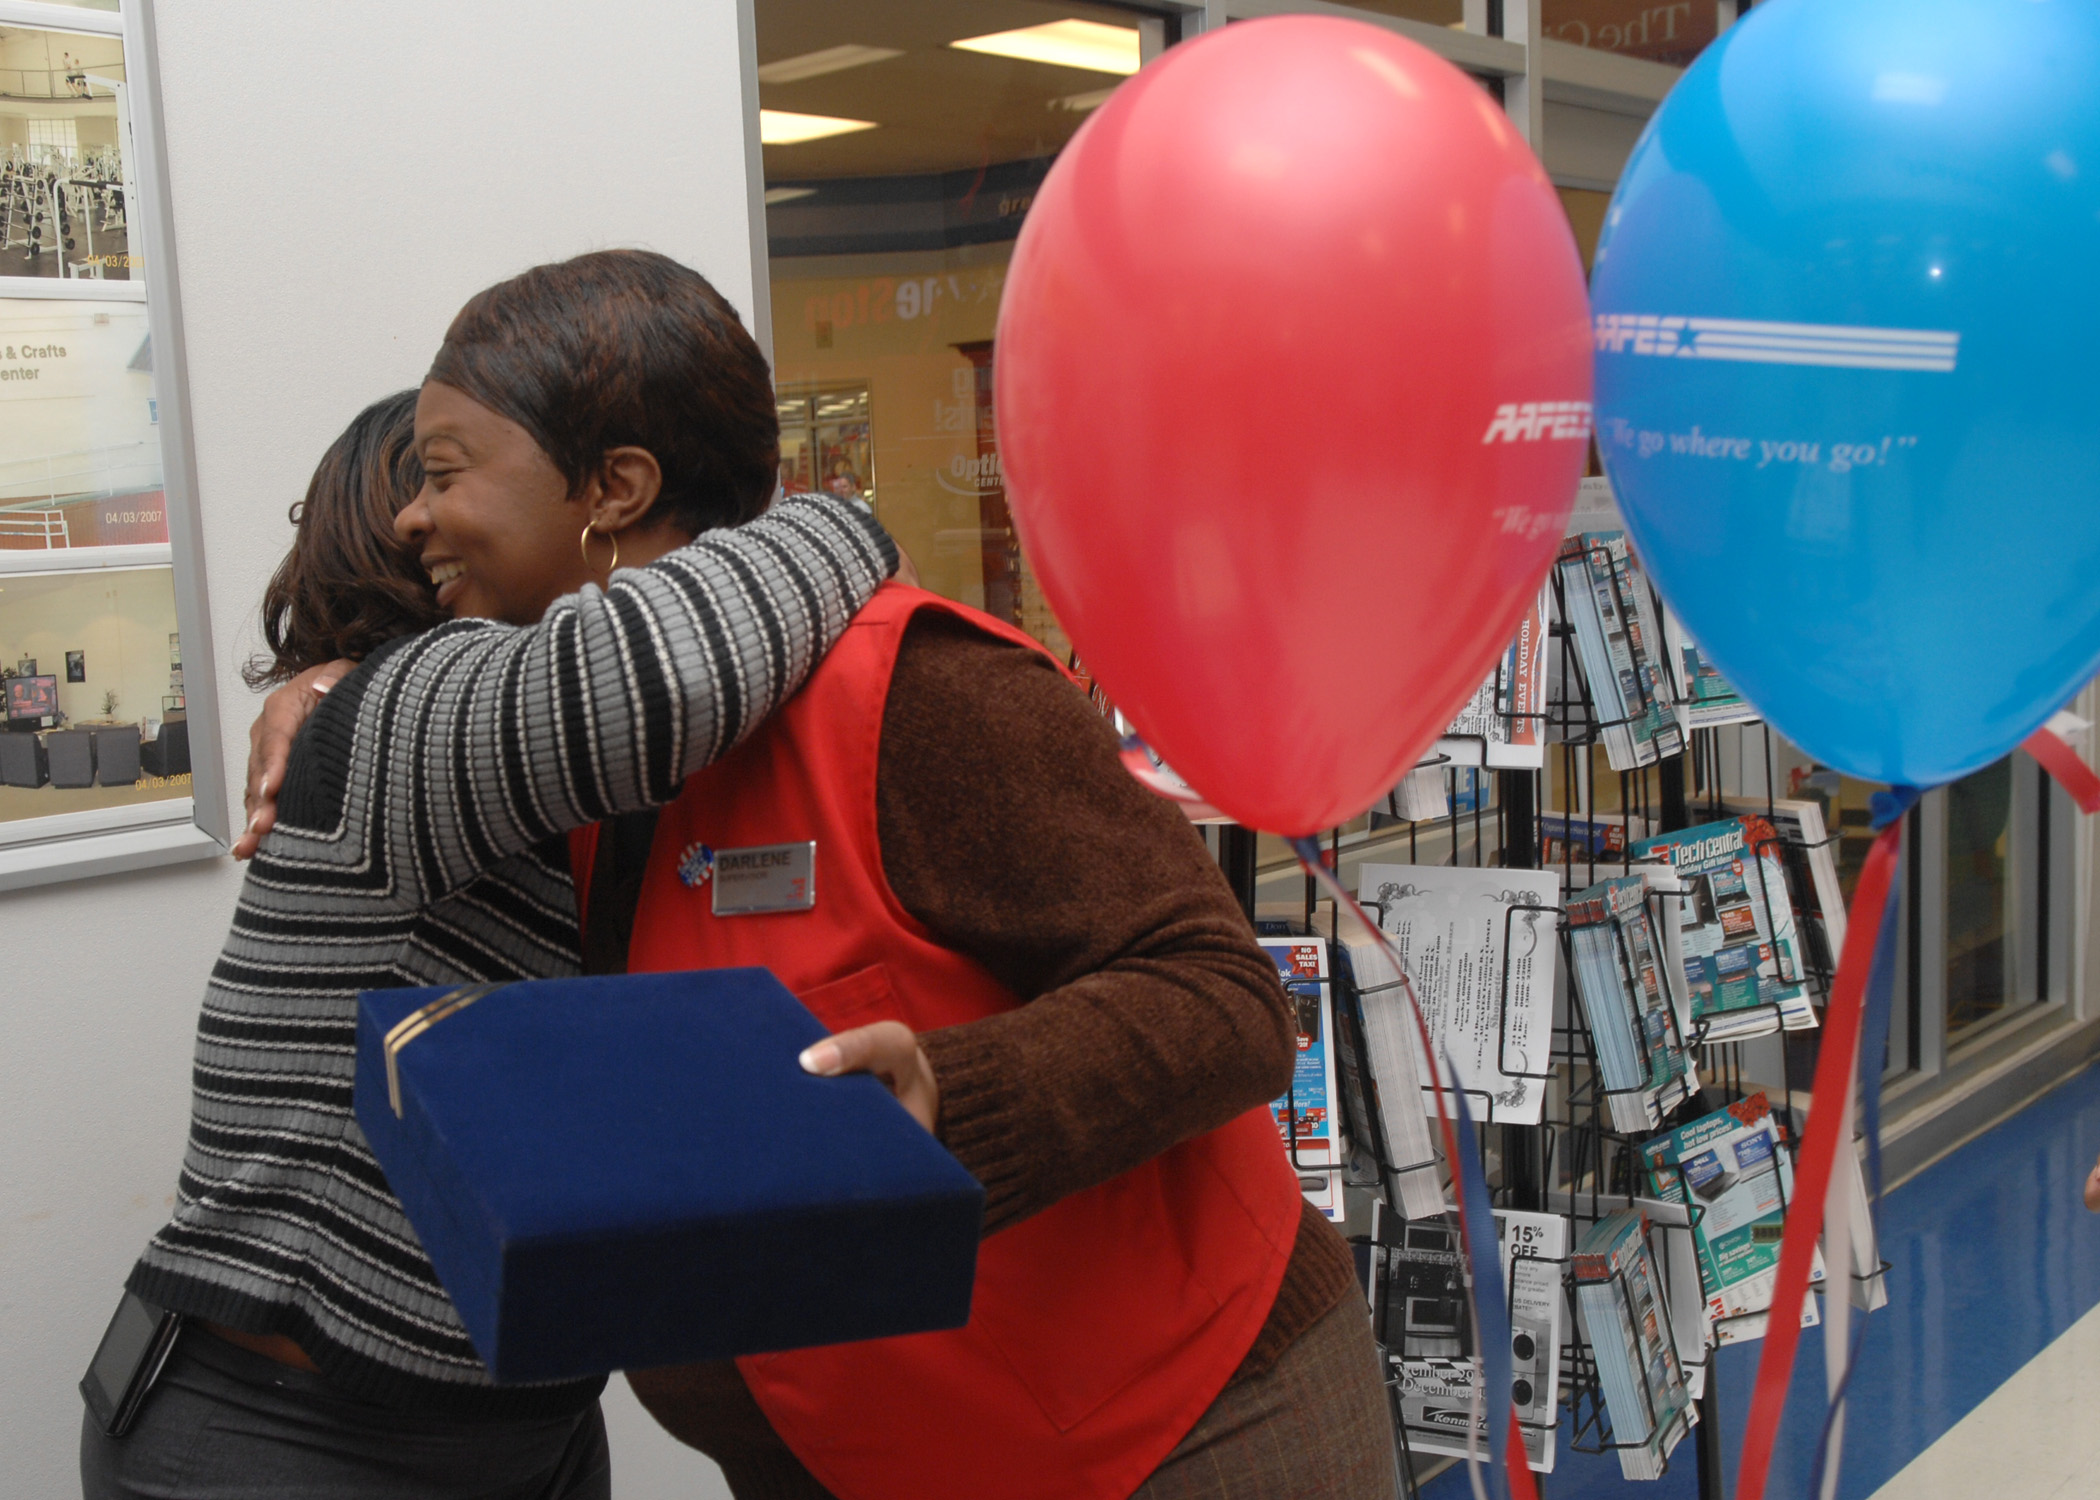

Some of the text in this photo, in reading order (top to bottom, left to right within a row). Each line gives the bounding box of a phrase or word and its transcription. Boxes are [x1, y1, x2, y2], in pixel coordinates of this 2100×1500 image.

[6, 344, 67, 359] & Crafts
[0, 366, 40, 380] enter
[1638, 430, 1664, 459] go
[1669, 425, 1752, 460] where
[1755, 437, 1820, 470] you
[105, 511, 162, 524] 04/03/2007
[1519, 619, 1530, 677] HOLIDAY
[135, 772, 192, 791] 04/03/2007
[1671, 828, 1744, 867] Tech Central
[719, 851, 792, 871] DARLENE
[1681, 1126, 1696, 1140] Cool
[1741, 1134, 1763, 1149] SONY
[1512, 1224, 1544, 1244] 15%
[1511, 1243, 1539, 1257] OFF
[1523, 1298, 1550, 1308] DELIVERY
[1402, 1377, 1471, 1399] December
[1433, 1413, 1490, 1431] Kenmre
